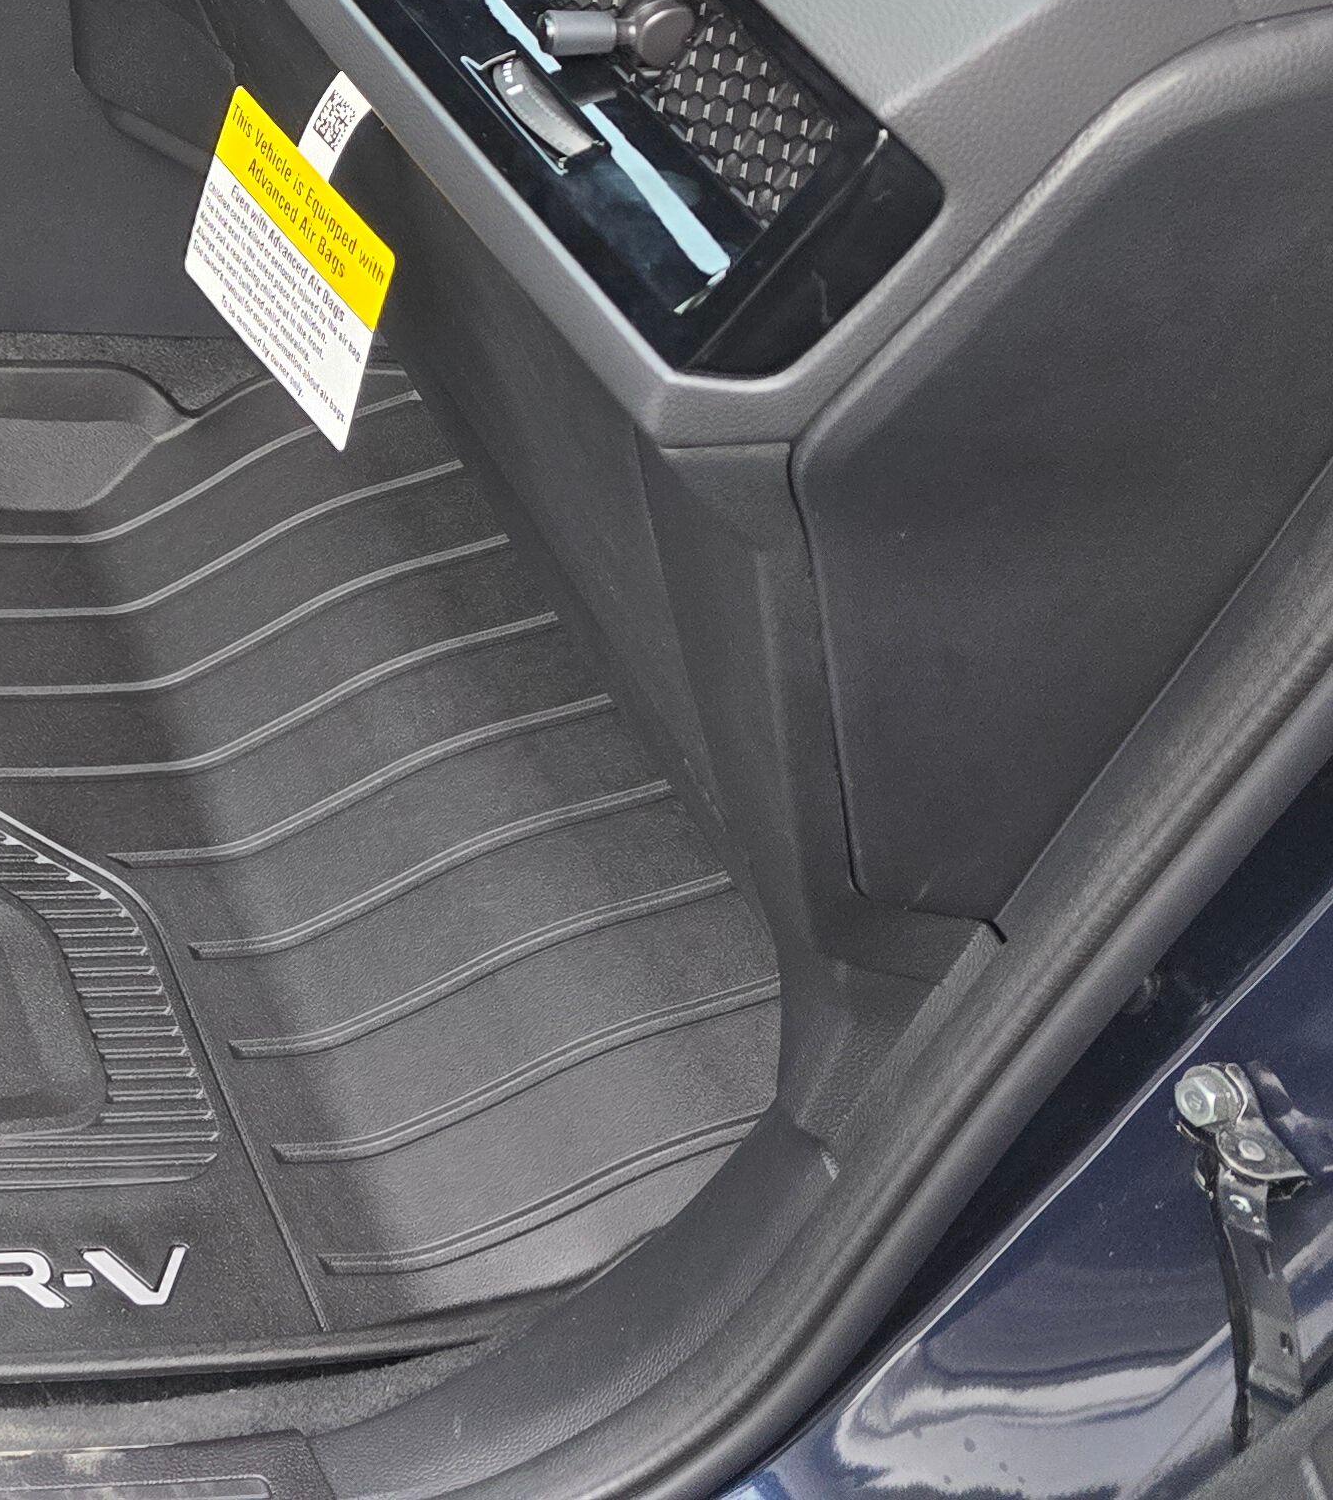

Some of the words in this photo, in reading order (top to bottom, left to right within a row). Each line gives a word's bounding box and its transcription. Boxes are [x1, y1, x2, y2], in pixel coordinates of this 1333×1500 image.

[230, 183, 251, 215] Even
[250, 205, 269, 235] with
[267, 225, 308, 281] Advanced
[307, 271, 322, 297] Air
[320, 287, 346, 326] Bags
[231, 103, 254, 139] This
[252, 127, 293, 184] Vehicle
[292, 172, 305, 197] is
[303, 185, 358, 260] Equipped
[357, 245, 385, 287] with
[247, 156, 299, 224] Advanced
[297, 213, 317, 246] Air
[315, 234, 347, 283] Bags
[337, 329, 348, 348] air
